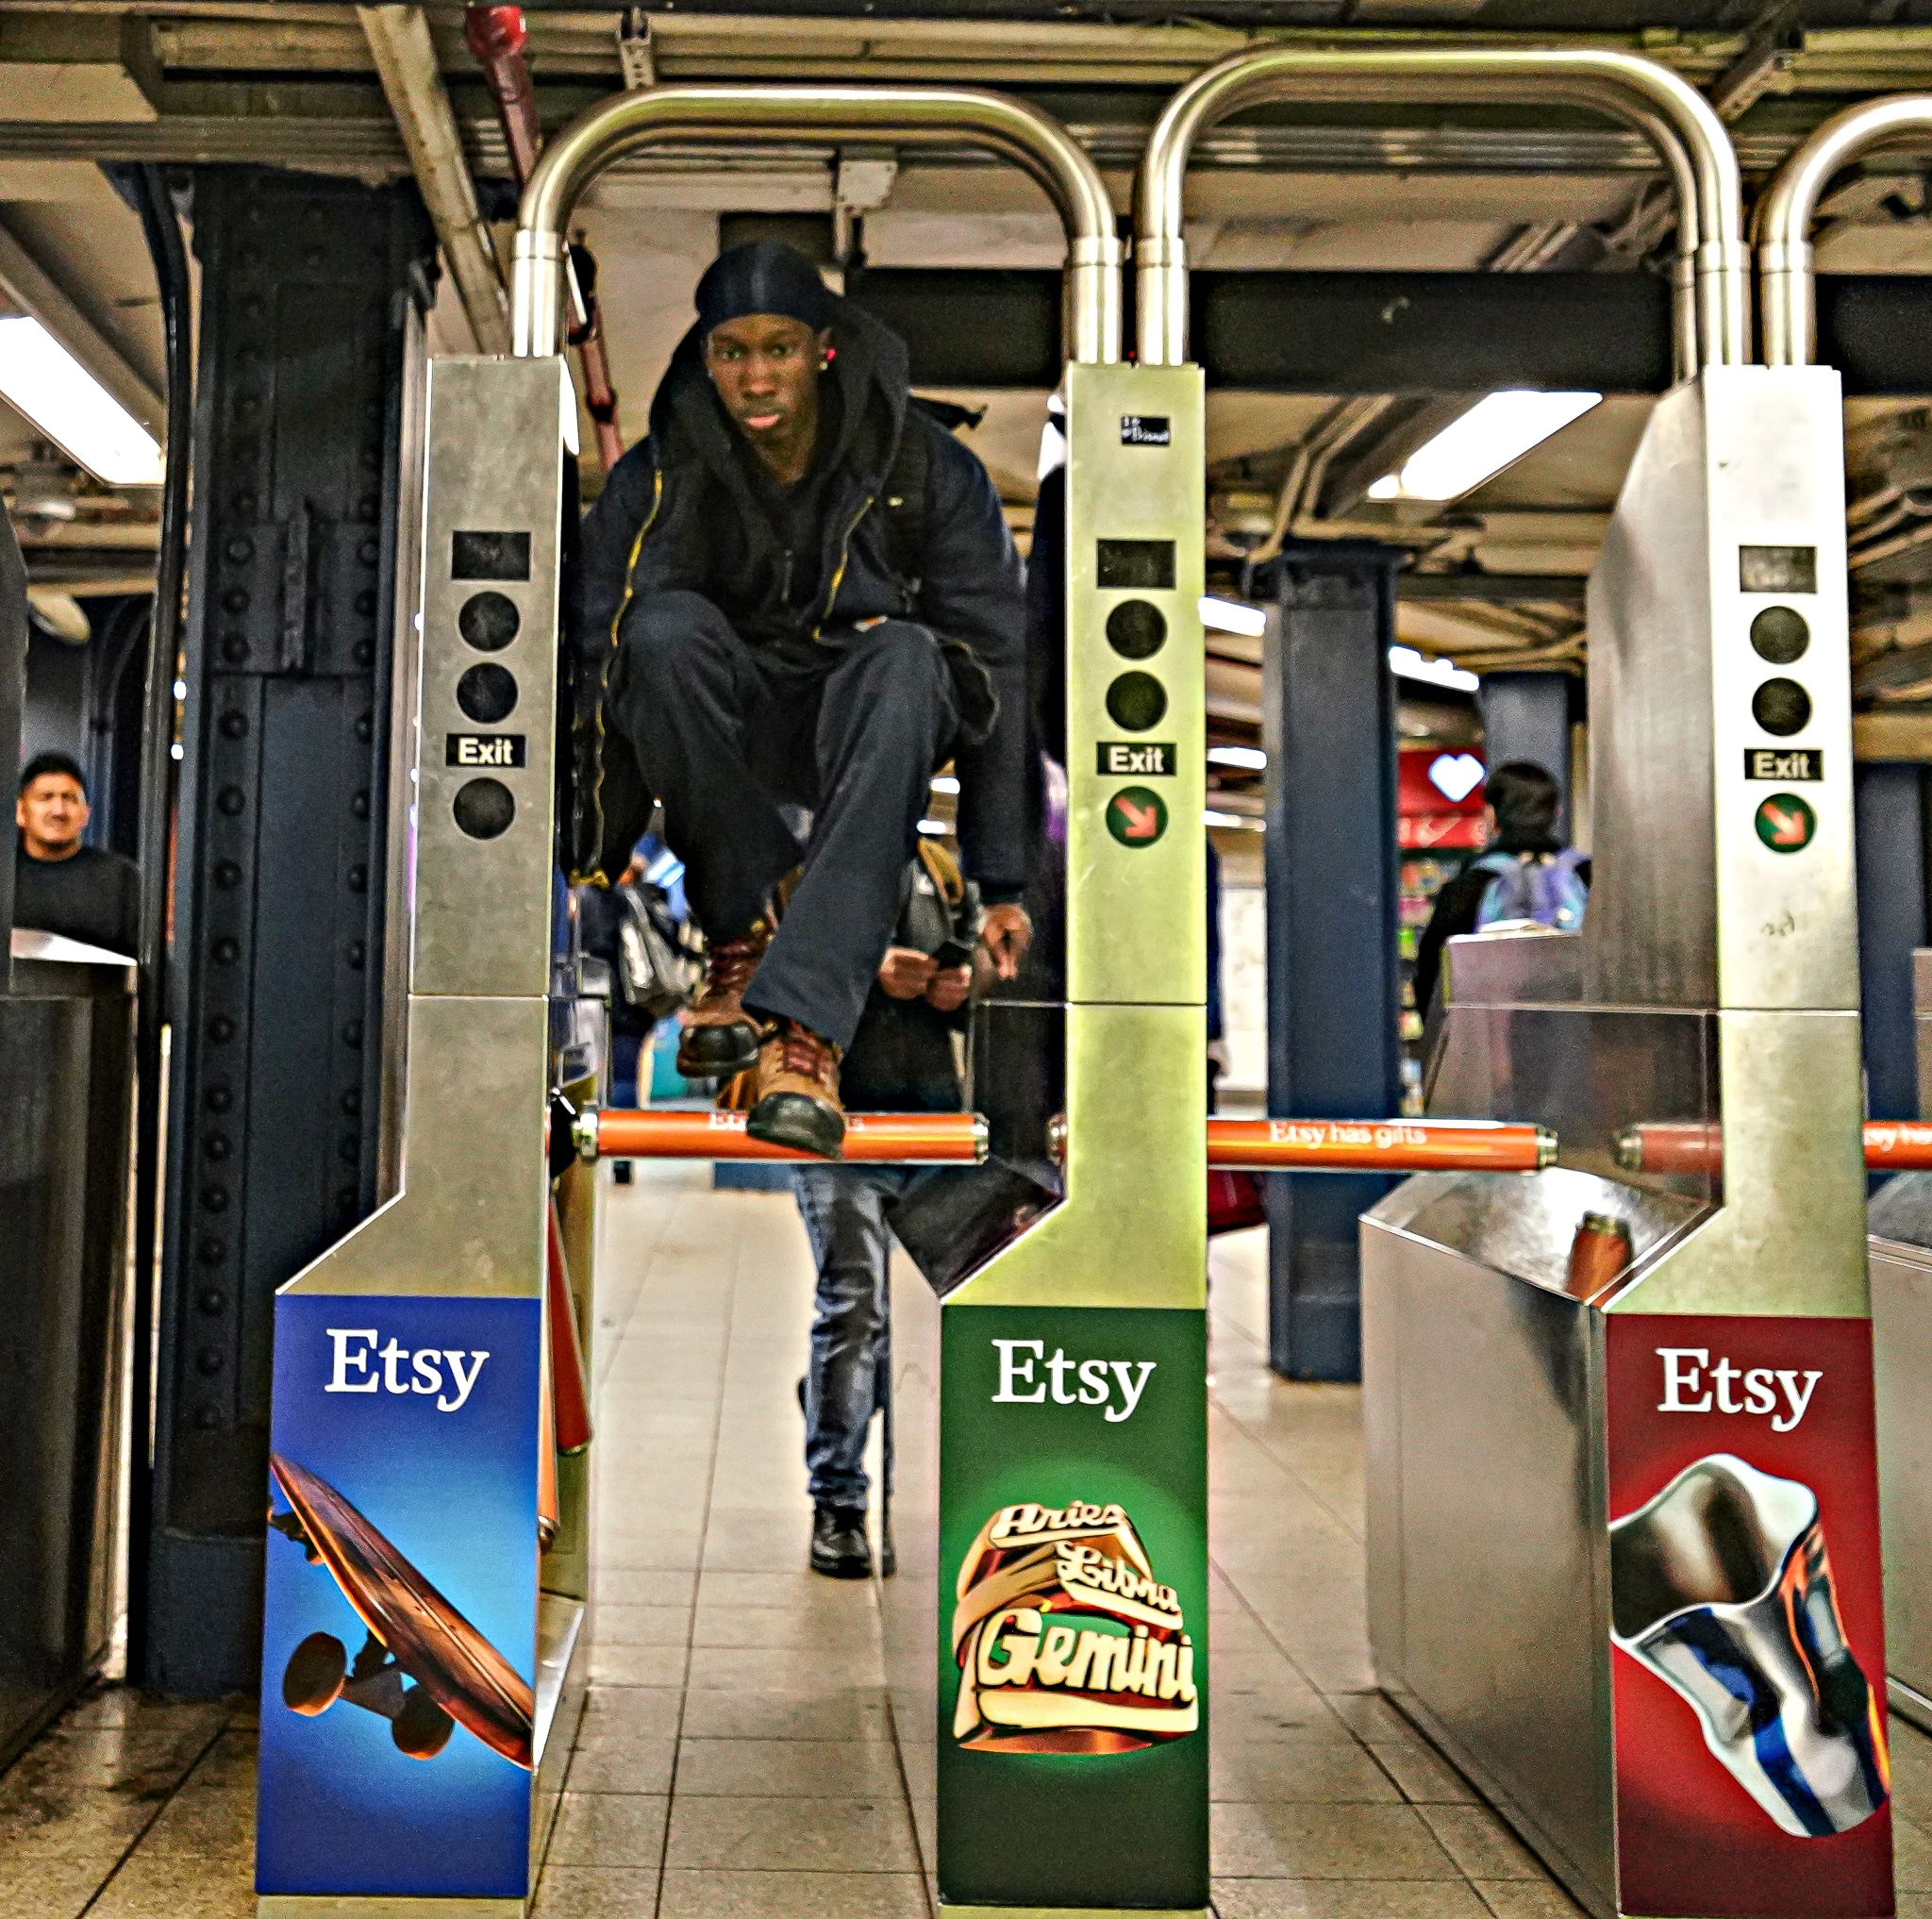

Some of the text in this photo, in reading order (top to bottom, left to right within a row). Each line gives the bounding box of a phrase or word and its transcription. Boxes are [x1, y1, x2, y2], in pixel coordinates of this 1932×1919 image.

[458, 737, 513, 765] Exit
[1108, 745, 1165, 773] Exit
[1753, 751, 1810, 779] Exit
[1270, 1121, 1427, 1149] Etsy has gifts
[324, 1328, 491, 1412] Etsy
[991, 1338, 1158, 1423] Etsy
[1655, 1346, 1824, 1433] Etsy
[991, 1499, 1125, 1540] Aries
[1056, 1540, 1181, 1614] Libra
[977, 1607, 1197, 1703] Gemini
